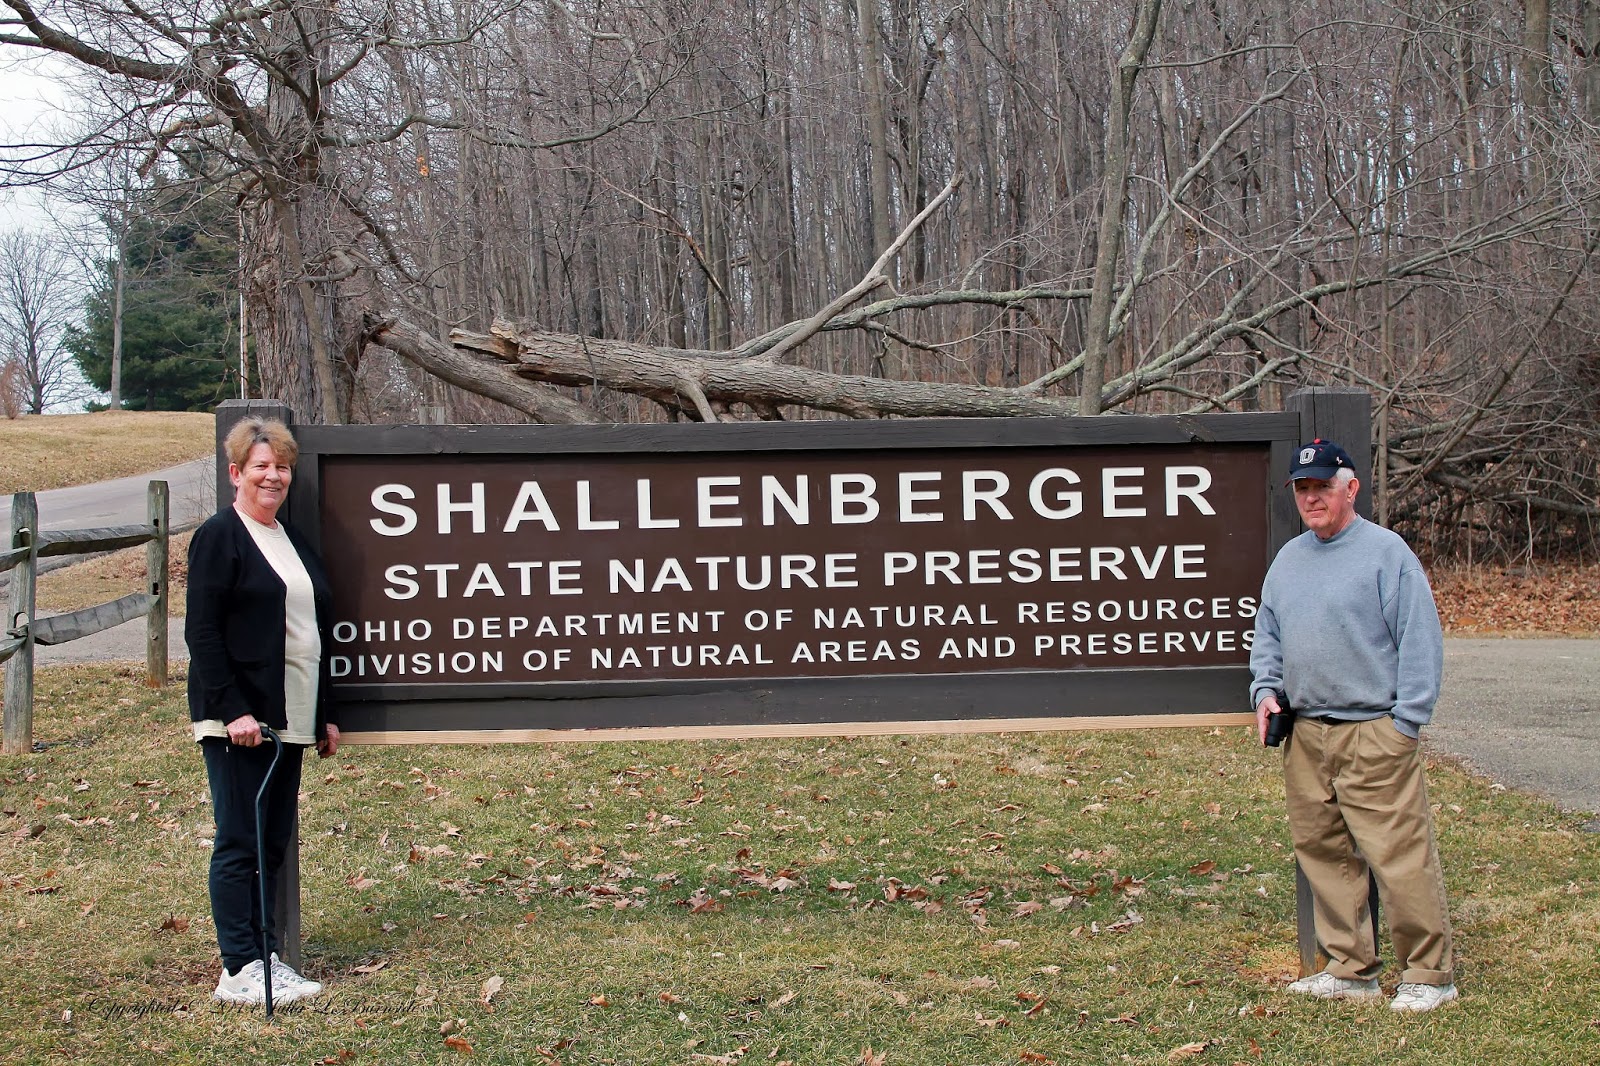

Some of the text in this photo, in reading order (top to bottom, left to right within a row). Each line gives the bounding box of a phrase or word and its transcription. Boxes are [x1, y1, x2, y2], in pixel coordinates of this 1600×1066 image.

[369, 465, 1217, 537] SHALLENBERGER
[383, 544, 1208, 600] STATE NATURE PRESERVE
[332, 596, 1257, 643] OHIO DEPARTMENT OF NATURAL RESOURCES
[329, 629, 1255, 677] DIVISION OF NATURAL AREAS AND PRESERVES
